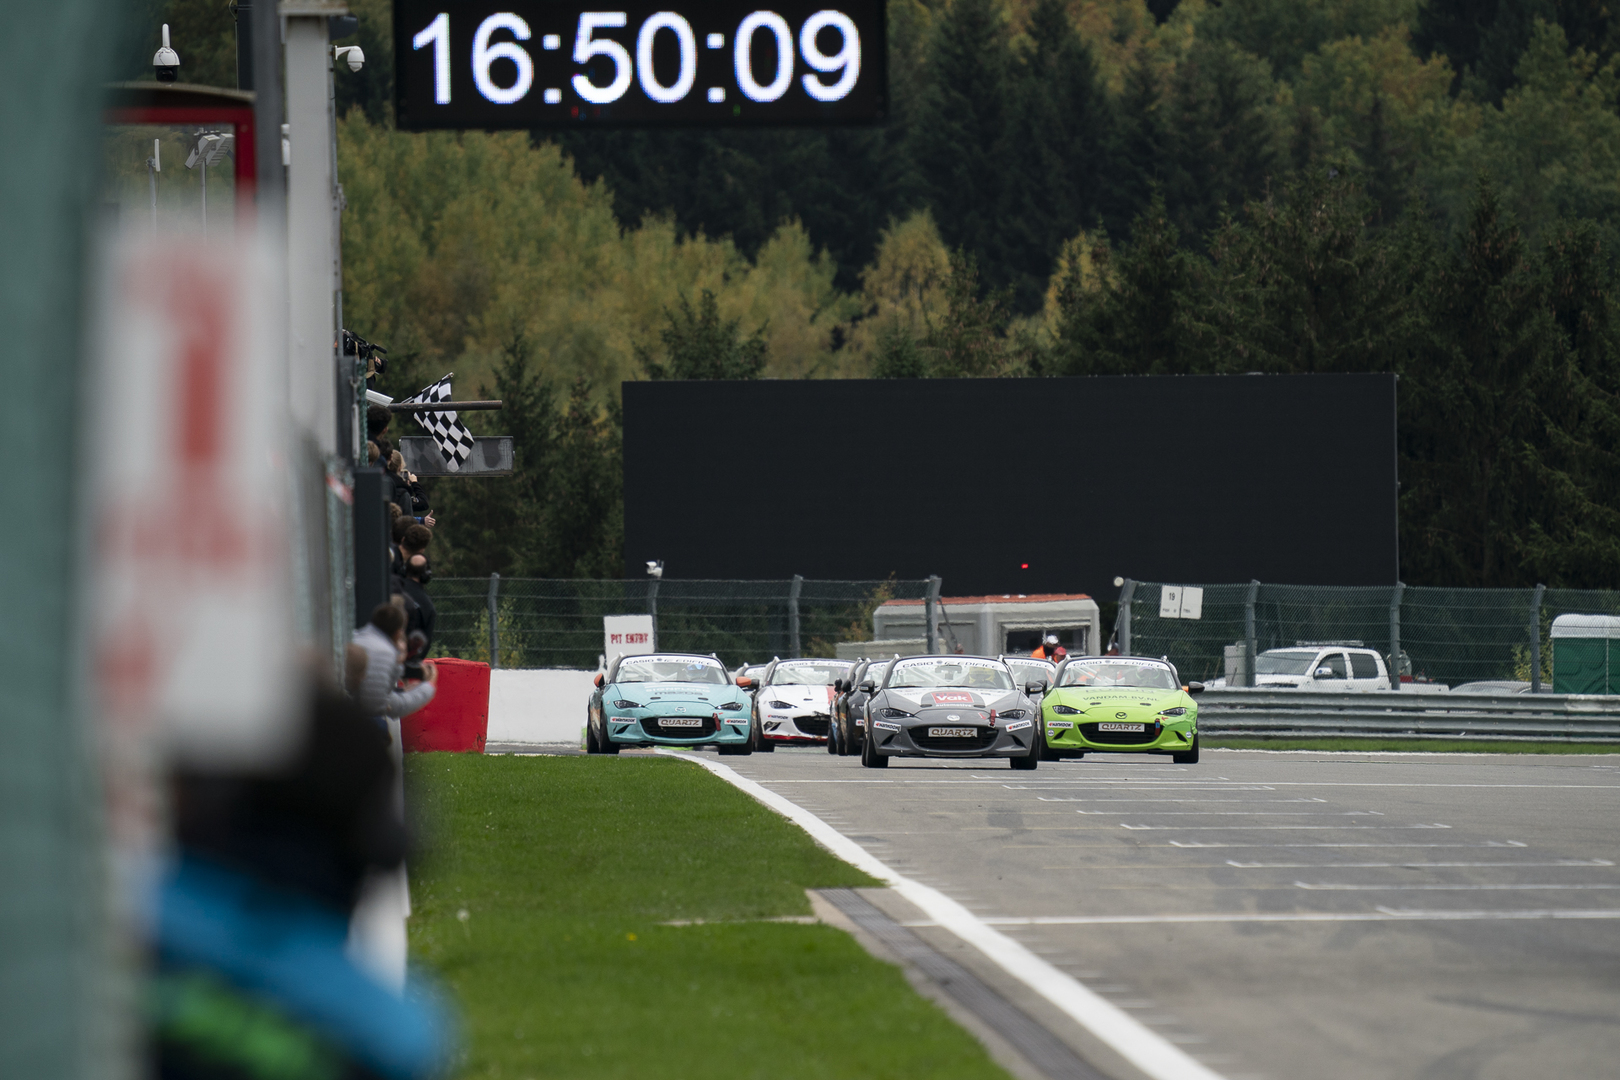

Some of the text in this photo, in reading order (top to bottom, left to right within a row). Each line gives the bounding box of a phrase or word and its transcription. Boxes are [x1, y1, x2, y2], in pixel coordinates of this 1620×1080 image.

[412, 9, 862, 105] 16:50:09
[610, 633, 649, 644] PIT ENTRY
[902, 661, 999, 669] CASIO EDIFICE
[1124, 660, 1163, 668] EDIFICE
[660, 718, 700, 727] QUARTZ
[931, 727, 976, 737] QUARTZ
[1101, 723, 1142, 732] QUARTZ
